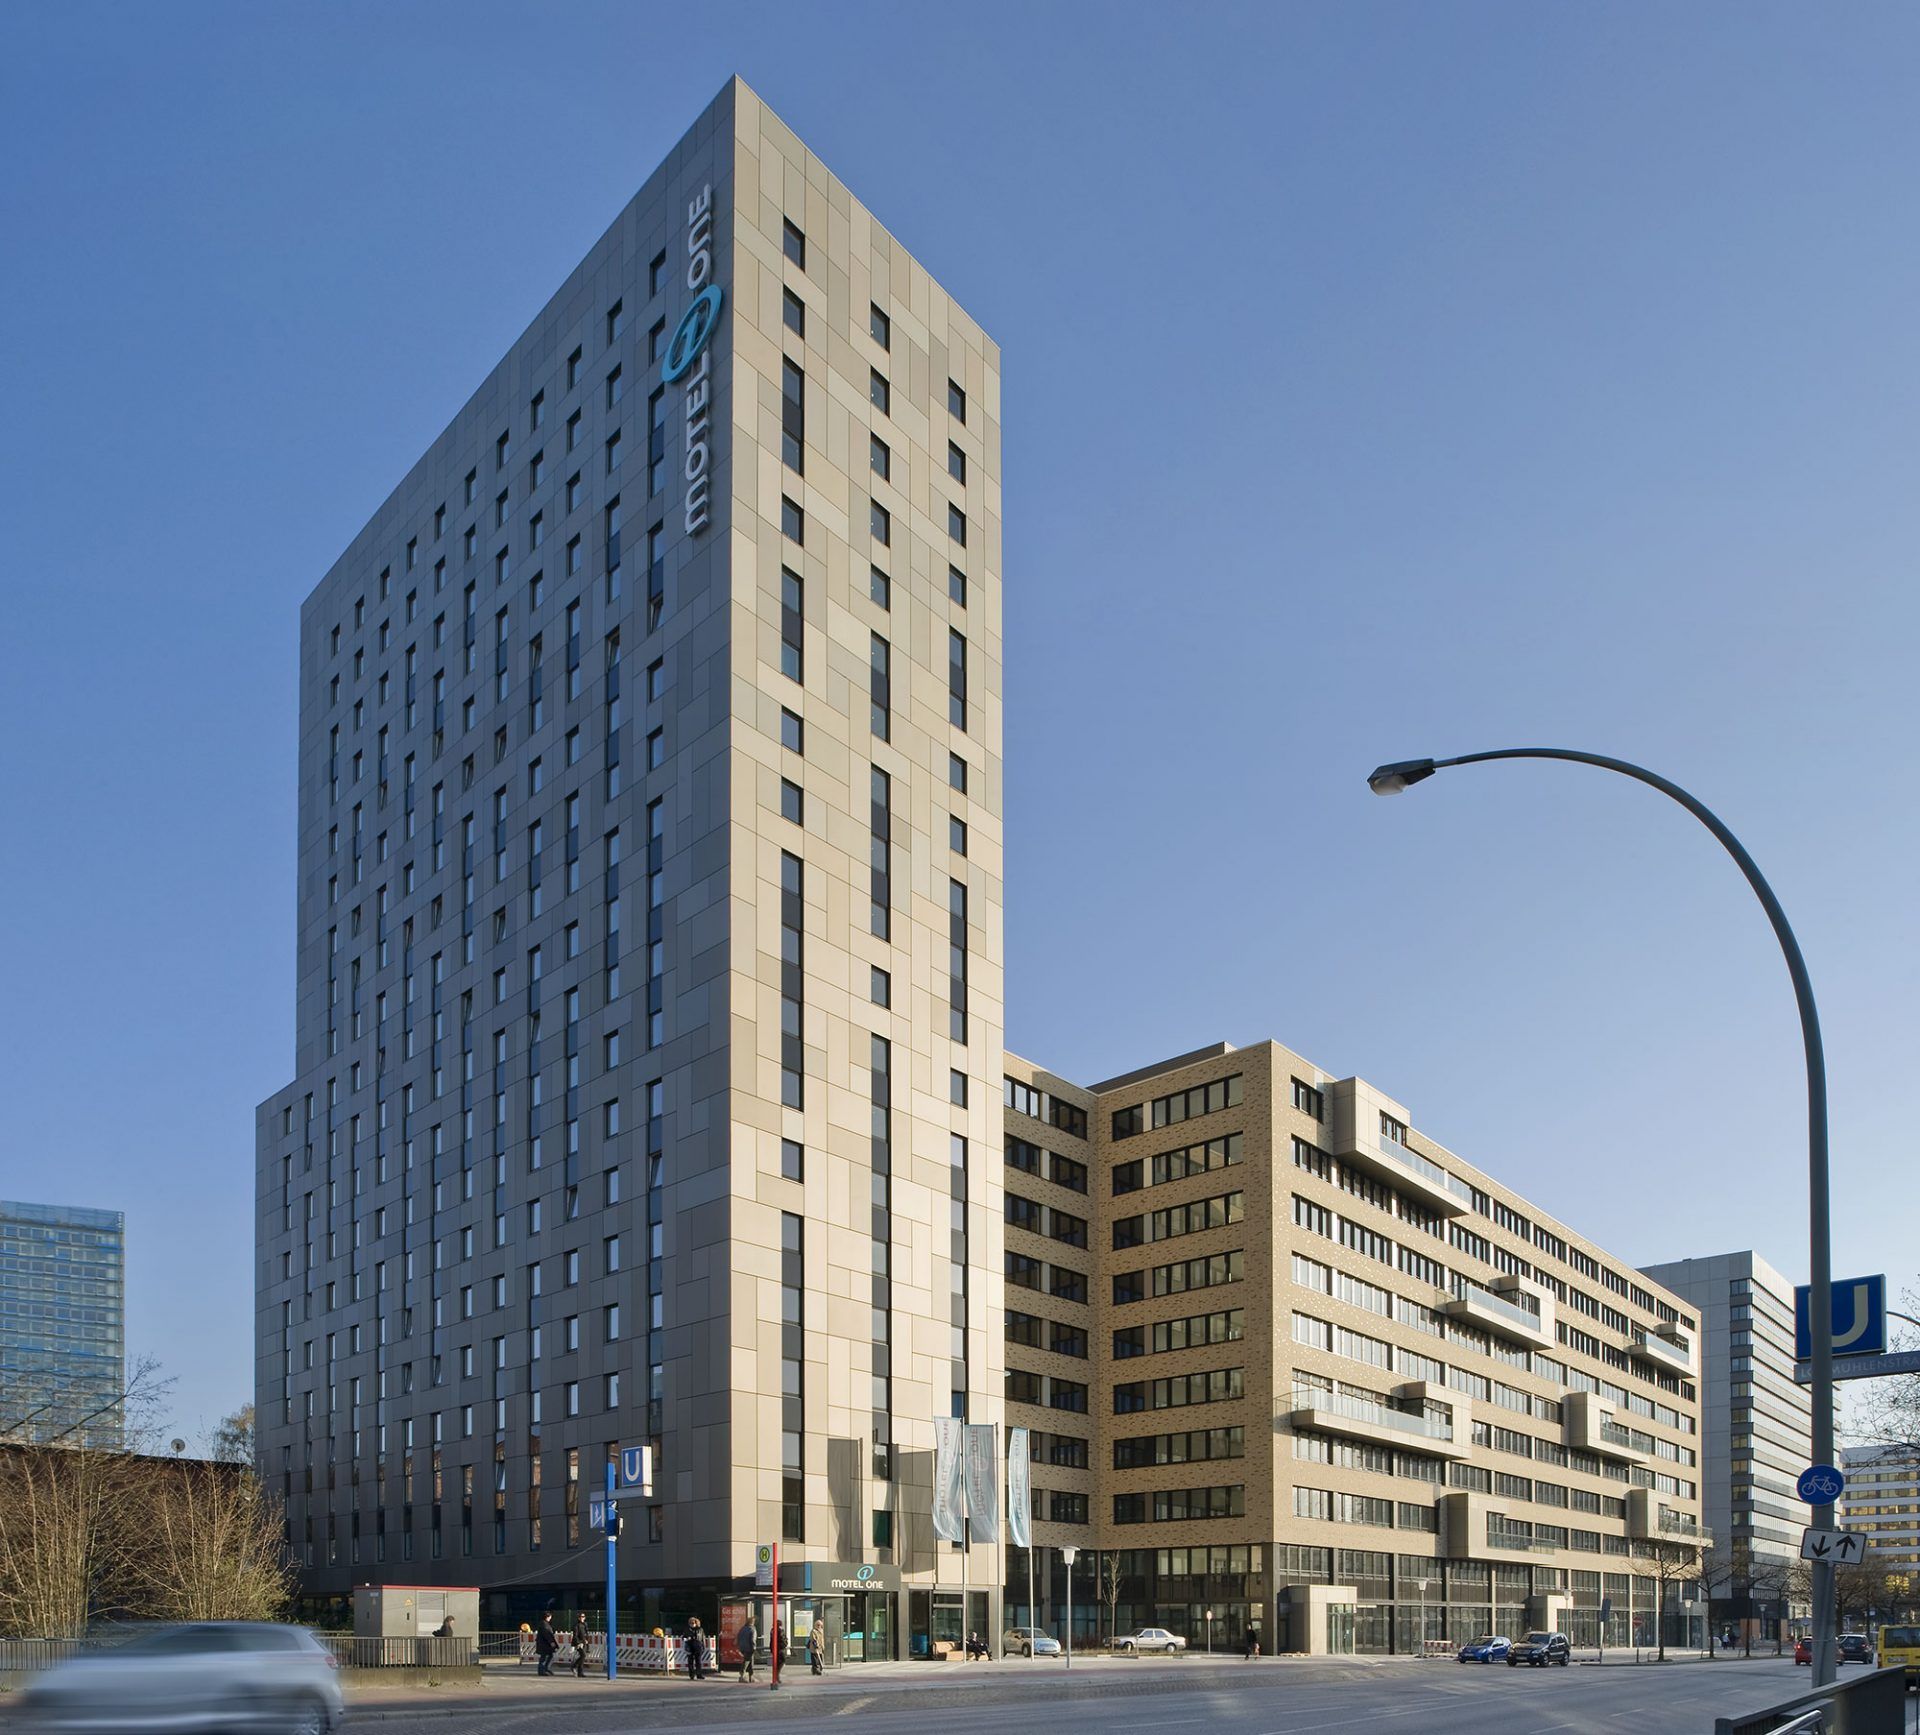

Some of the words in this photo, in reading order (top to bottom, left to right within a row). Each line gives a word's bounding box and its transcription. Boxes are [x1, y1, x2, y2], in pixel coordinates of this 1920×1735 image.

[1808, 1283, 1868, 1348] U
[1801, 1356, 1920, 1378] LMÜHLENSTRA
[625, 1451, 640, 1481] U
[831, 1579, 864, 1588] MOTEL
[865, 1580, 884, 1589] ONE
